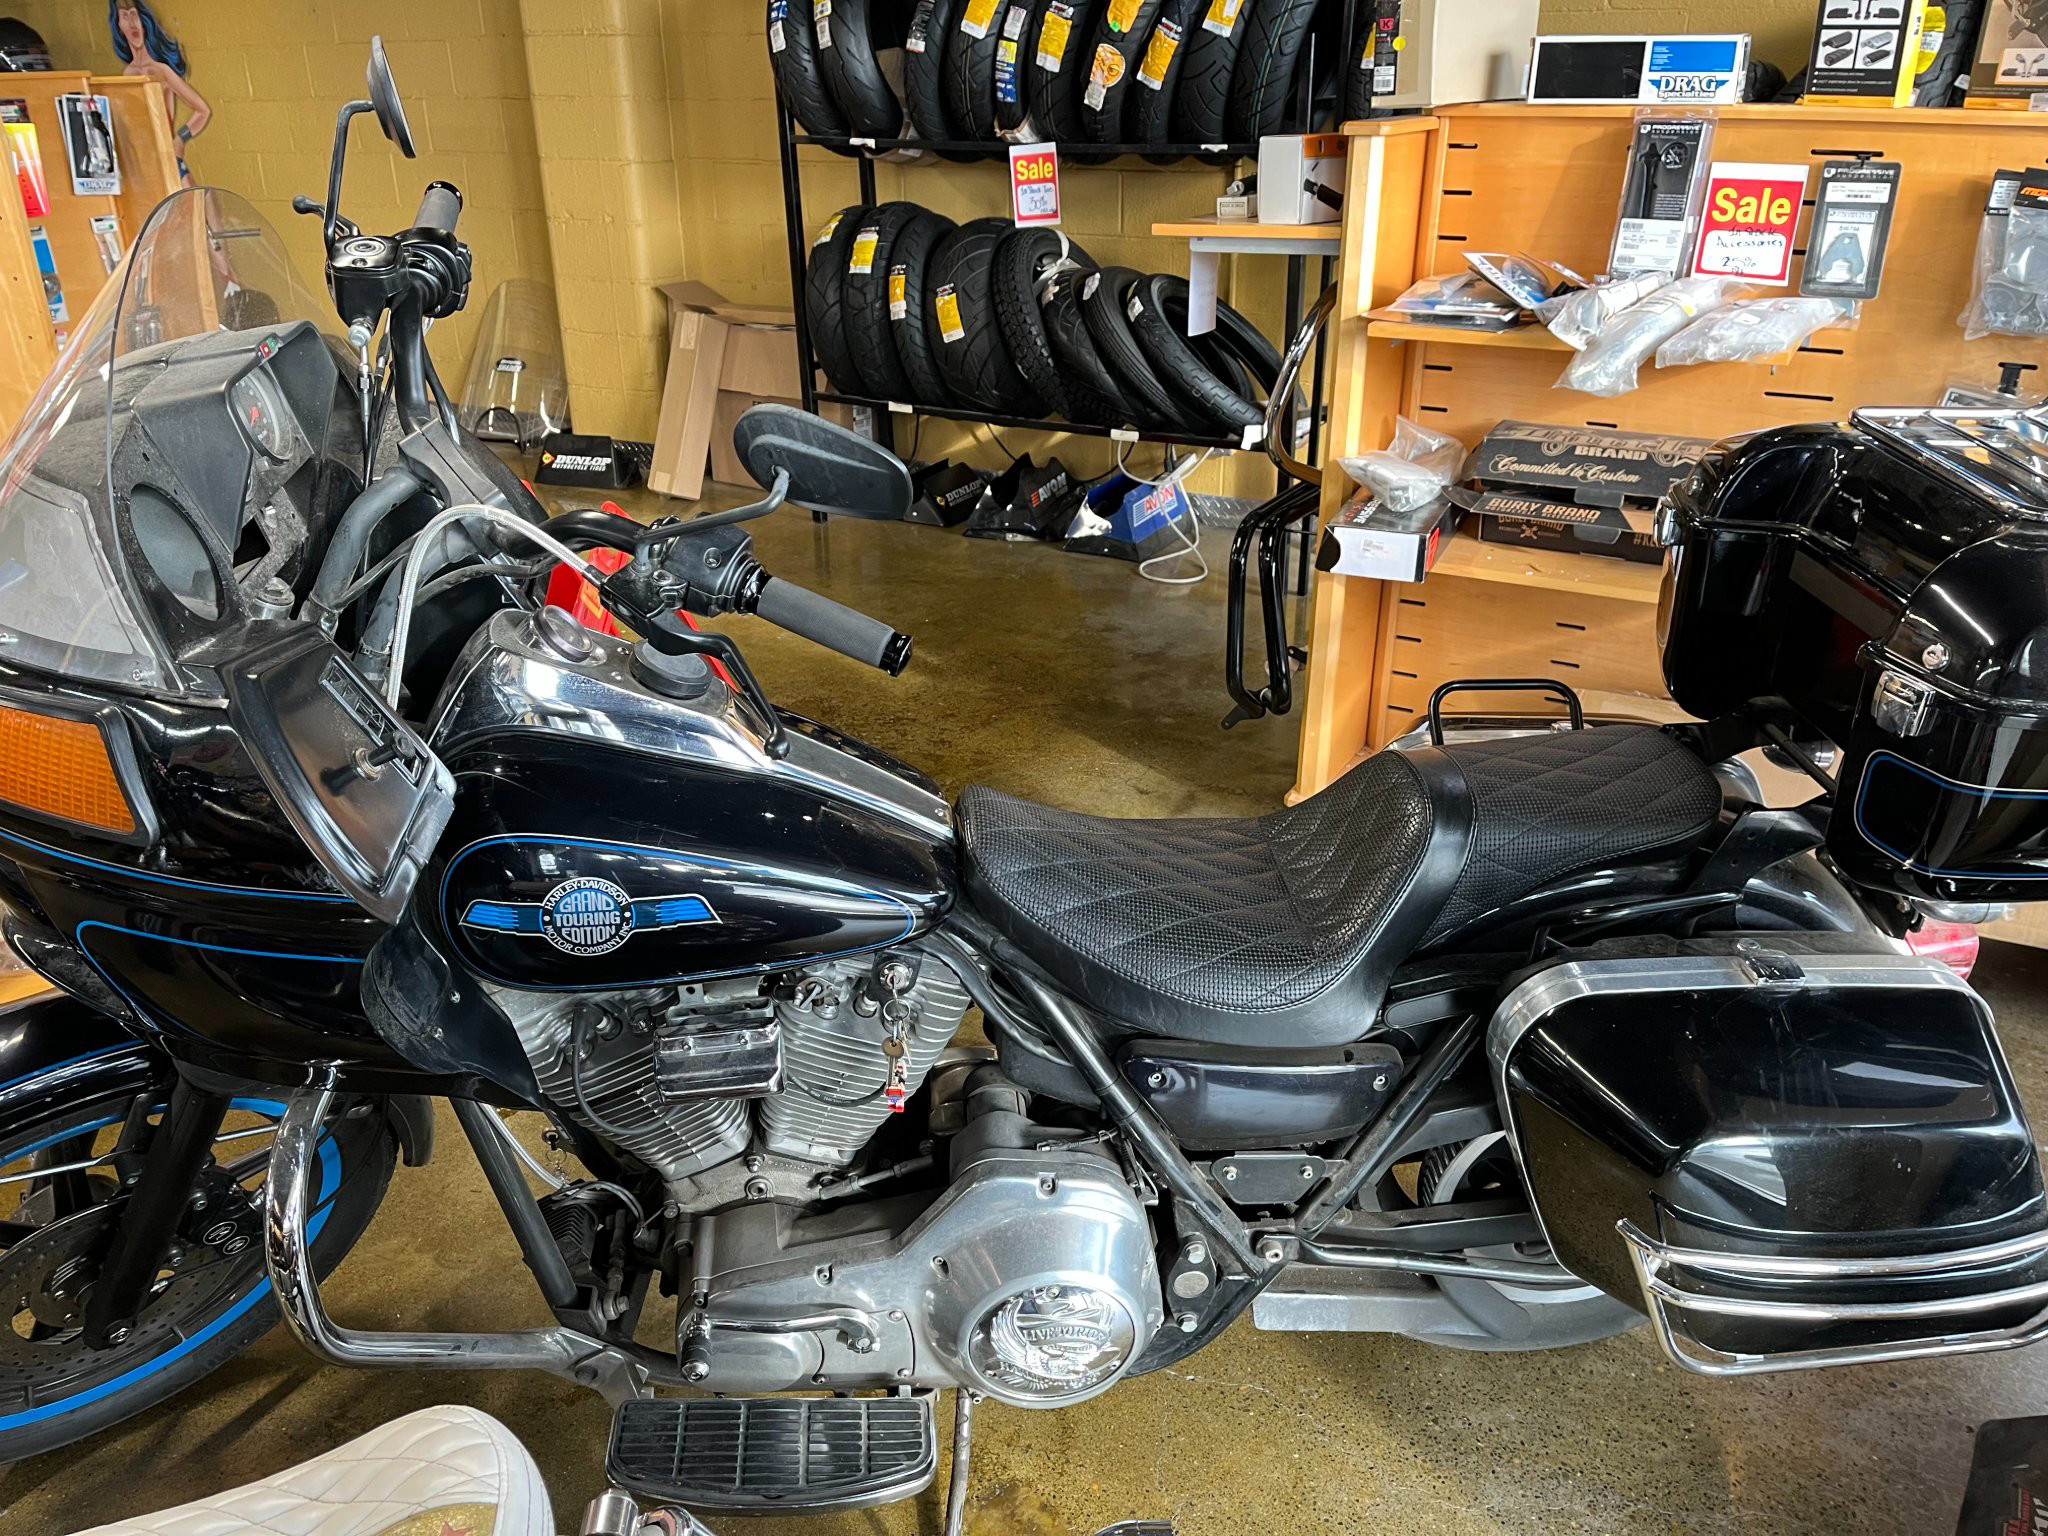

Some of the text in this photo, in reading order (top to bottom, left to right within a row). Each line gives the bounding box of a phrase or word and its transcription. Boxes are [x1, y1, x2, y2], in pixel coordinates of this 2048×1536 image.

[1660, 76, 1717, 92] DRAG
[1016, 157, 1053, 181] Sale
[1711, 187, 1792, 225] Sale
[554, 454, 612, 466] DUNLOP
[1574, 445, 1648, 461] BRAND
[1488, 453, 1641, 484] Committed to Custom
[945, 479, 983, 502] DUNLOP
[1039, 472, 1066, 501] AVON
[1487, 497, 1601, 519] BURLY BRAND
[559, 891, 614, 913] GRAND
[553, 910, 621, 927] TOURING
[544, 925, 574, 951] MOTOR
[574, 935, 622, 954] COMPANY
[561, 925, 616, 945] EDITION
[1022, 1328, 1055, 1341] LIVE
